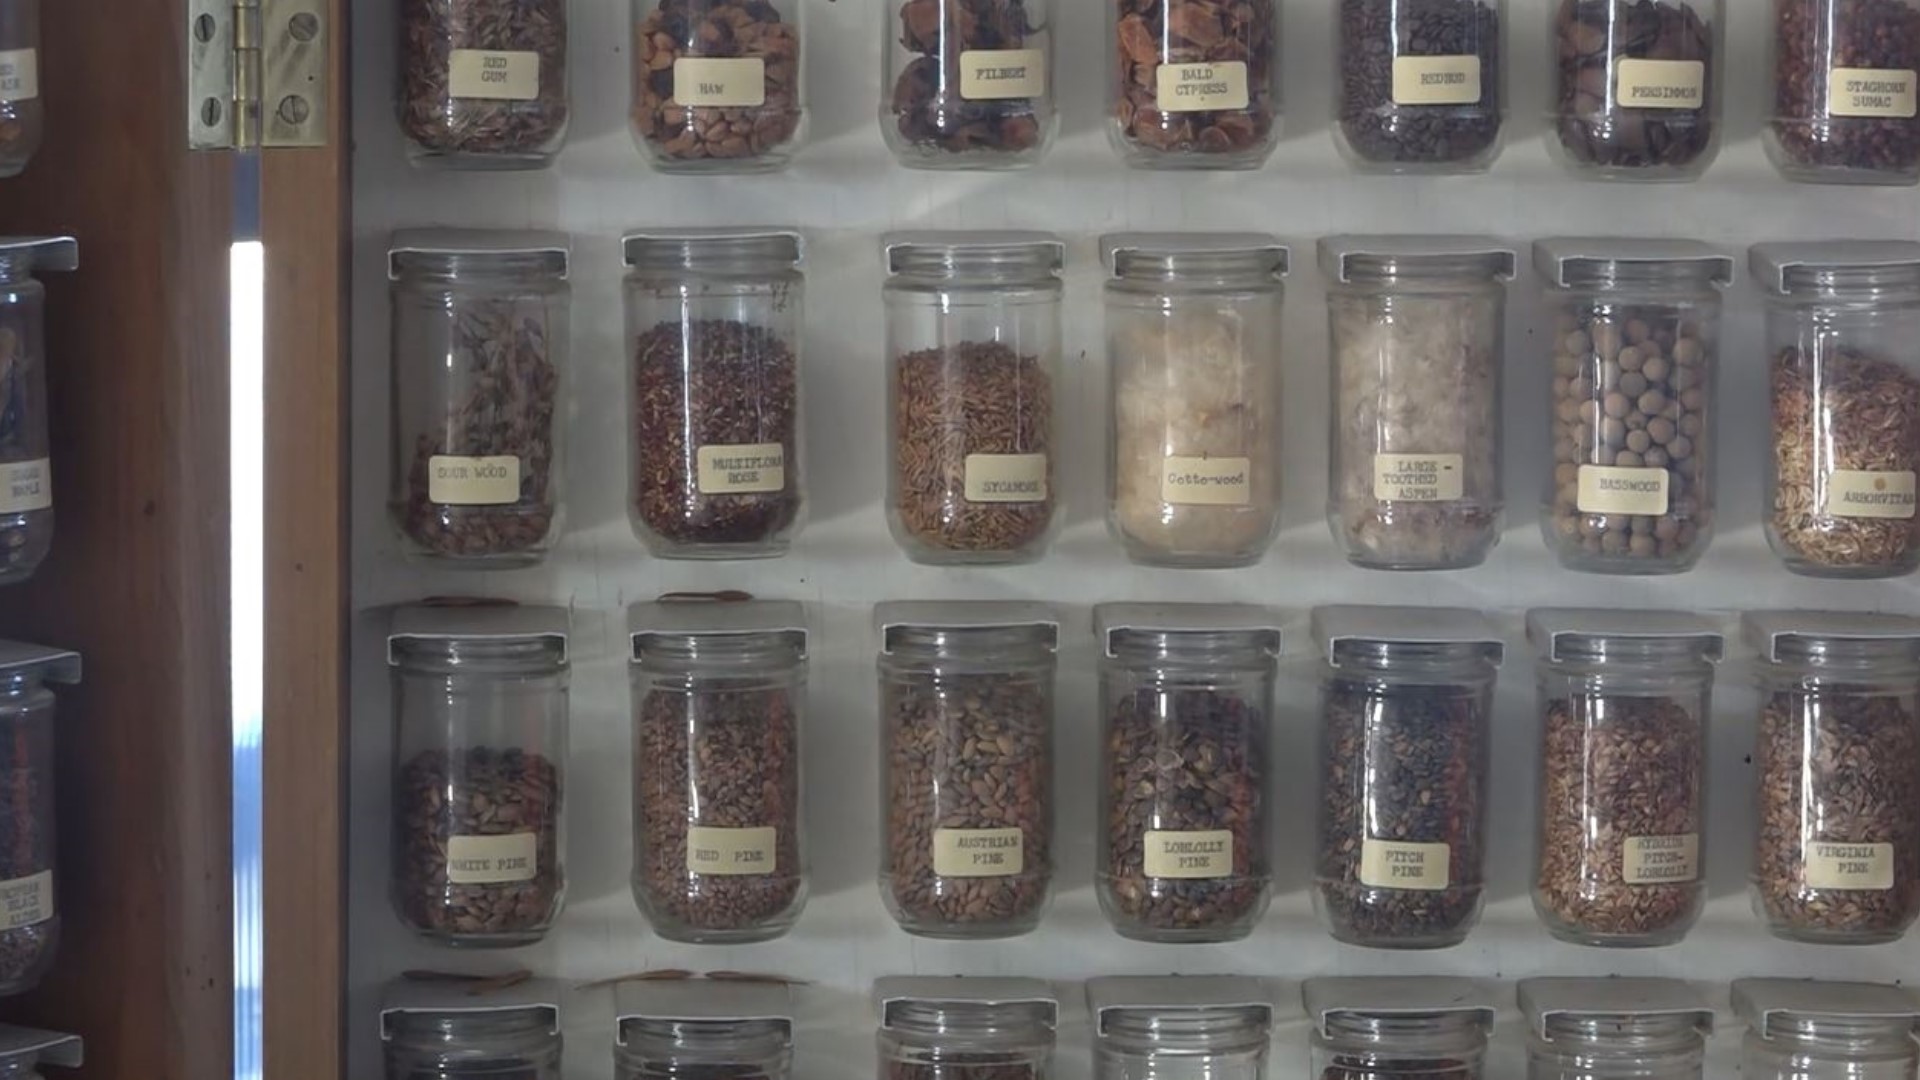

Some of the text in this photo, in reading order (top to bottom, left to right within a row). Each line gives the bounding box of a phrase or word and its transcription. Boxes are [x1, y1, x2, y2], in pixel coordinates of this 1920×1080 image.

[483, 57, 507, 69] RED
[482, 71, 507, 83] GUM
[976, 67, 1027, 80] FILBERT
[1182, 68, 1213, 80] BALD
[700, 83, 724, 95] HAW
[1175, 83, 1228, 95] CYPRESS
[1846, 80, 1906, 93] STAGHORN
[1852, 96, 1891, 107] SUMAC
[475, 466, 507, 478] WOOD
[1398, 461, 1437, 472] LARGE
[728, 473, 760, 484] ROSE
[1383, 474, 1437, 485] TOOTHED
[1600, 478, 1661, 491] BASSWOOD
[1398, 488, 1437, 499] ASPEN
[957, 836, 1018, 848] AUSTRIAN
[1164, 841, 1224, 853] LOBLOLLY
[695, 850, 764, 862] RED PINE
[1386, 851, 1424, 863] PITCH
[1817, 846, 1875, 858] VIRGINIA
[498, 857, 526, 870] PINE
[973, 853, 1004, 864] PINE
[1179, 856, 1210, 868] PINE
[1392, 866, 1423, 878] PINE
[1838, 862, 1868, 873] PINE
